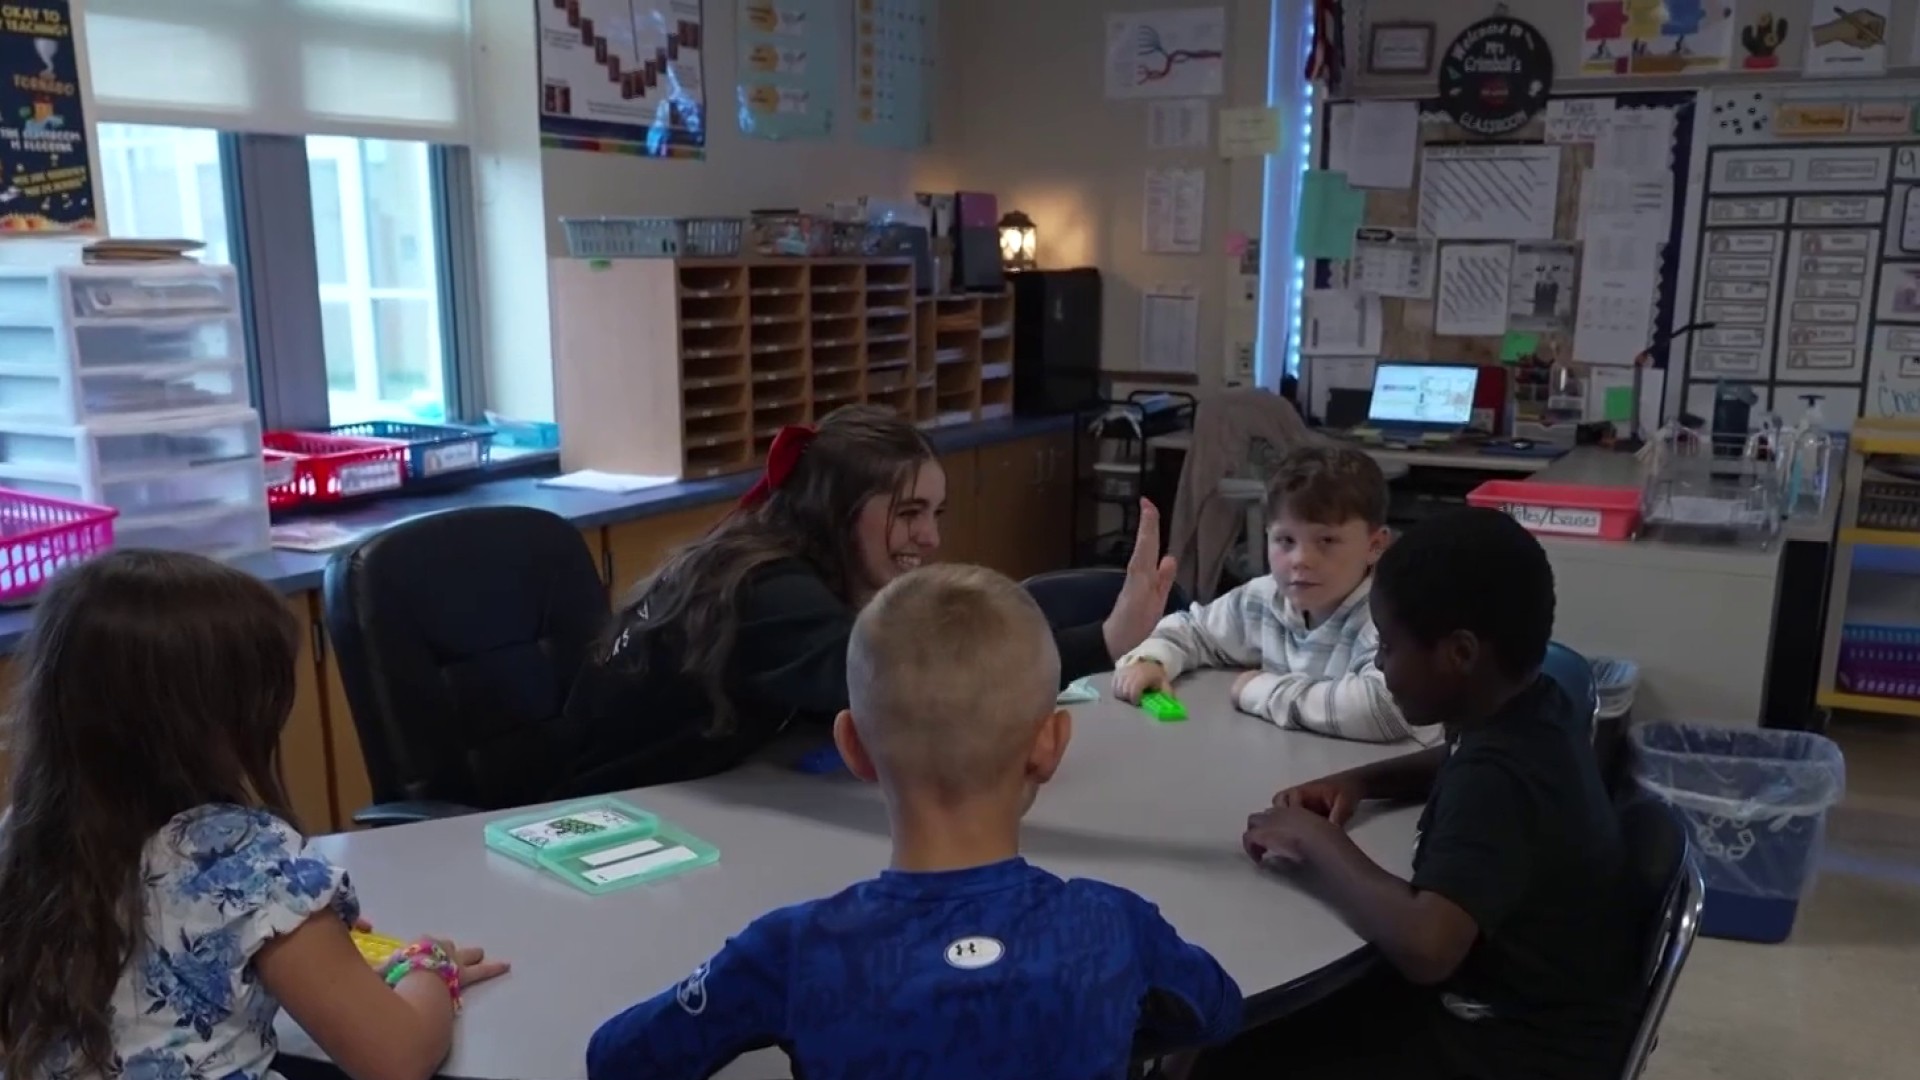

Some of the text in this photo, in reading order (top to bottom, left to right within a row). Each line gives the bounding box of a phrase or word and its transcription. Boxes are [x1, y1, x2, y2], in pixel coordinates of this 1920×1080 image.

[2, 5, 61, 22] OKAY TO
[13, 75, 75, 95] TORNADO
